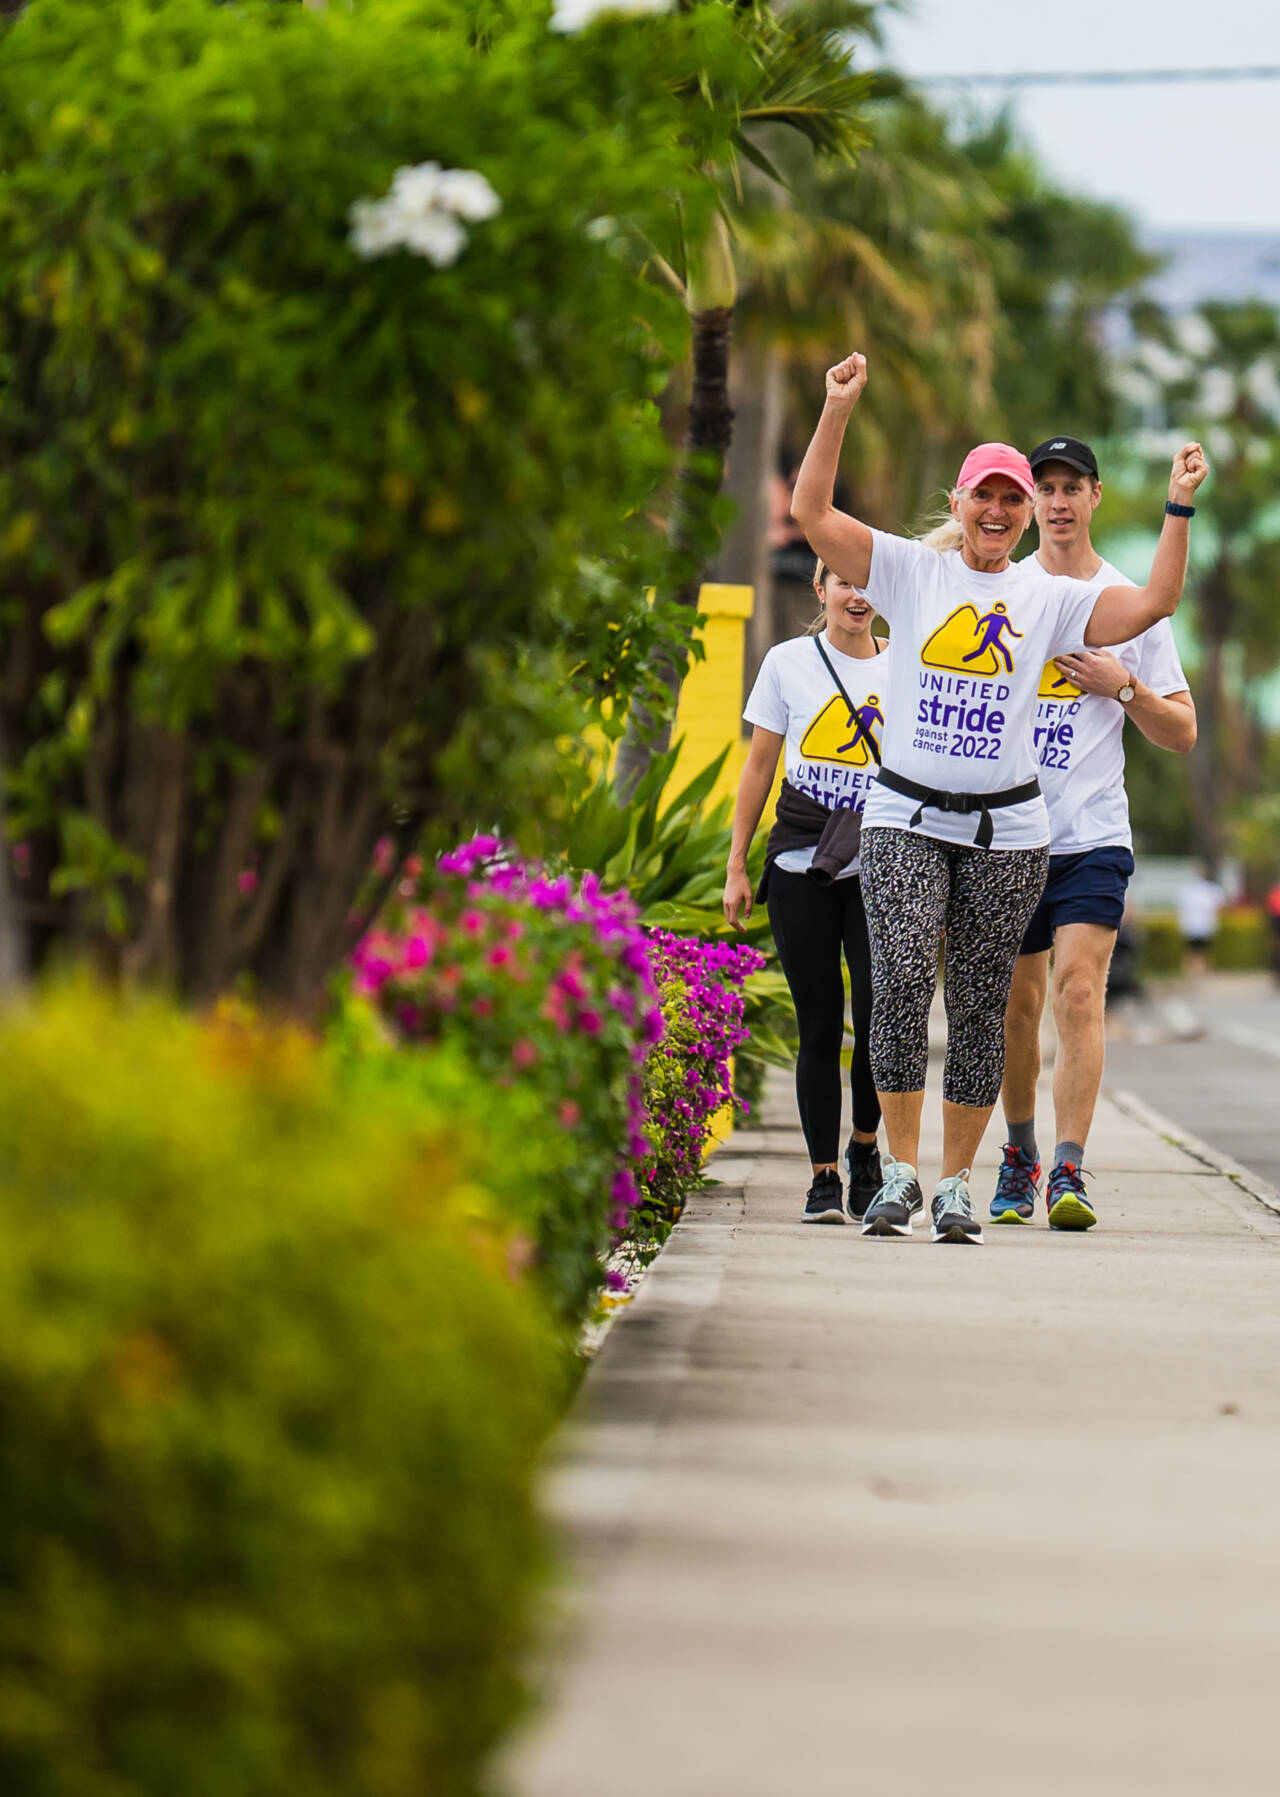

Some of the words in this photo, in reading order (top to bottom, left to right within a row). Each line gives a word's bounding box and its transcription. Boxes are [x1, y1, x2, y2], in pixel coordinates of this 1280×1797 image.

[919, 672, 1010, 701] UNIFIED
[917, 694, 1005, 734] stride
[1037, 702, 1081, 718] IFID
[915, 726, 948, 742] aganst
[1033, 721, 1074, 746] rie
[912, 738, 948, 754] cancer
[949, 734, 1001, 760] 2022
[1039, 745, 1071, 770] 022
